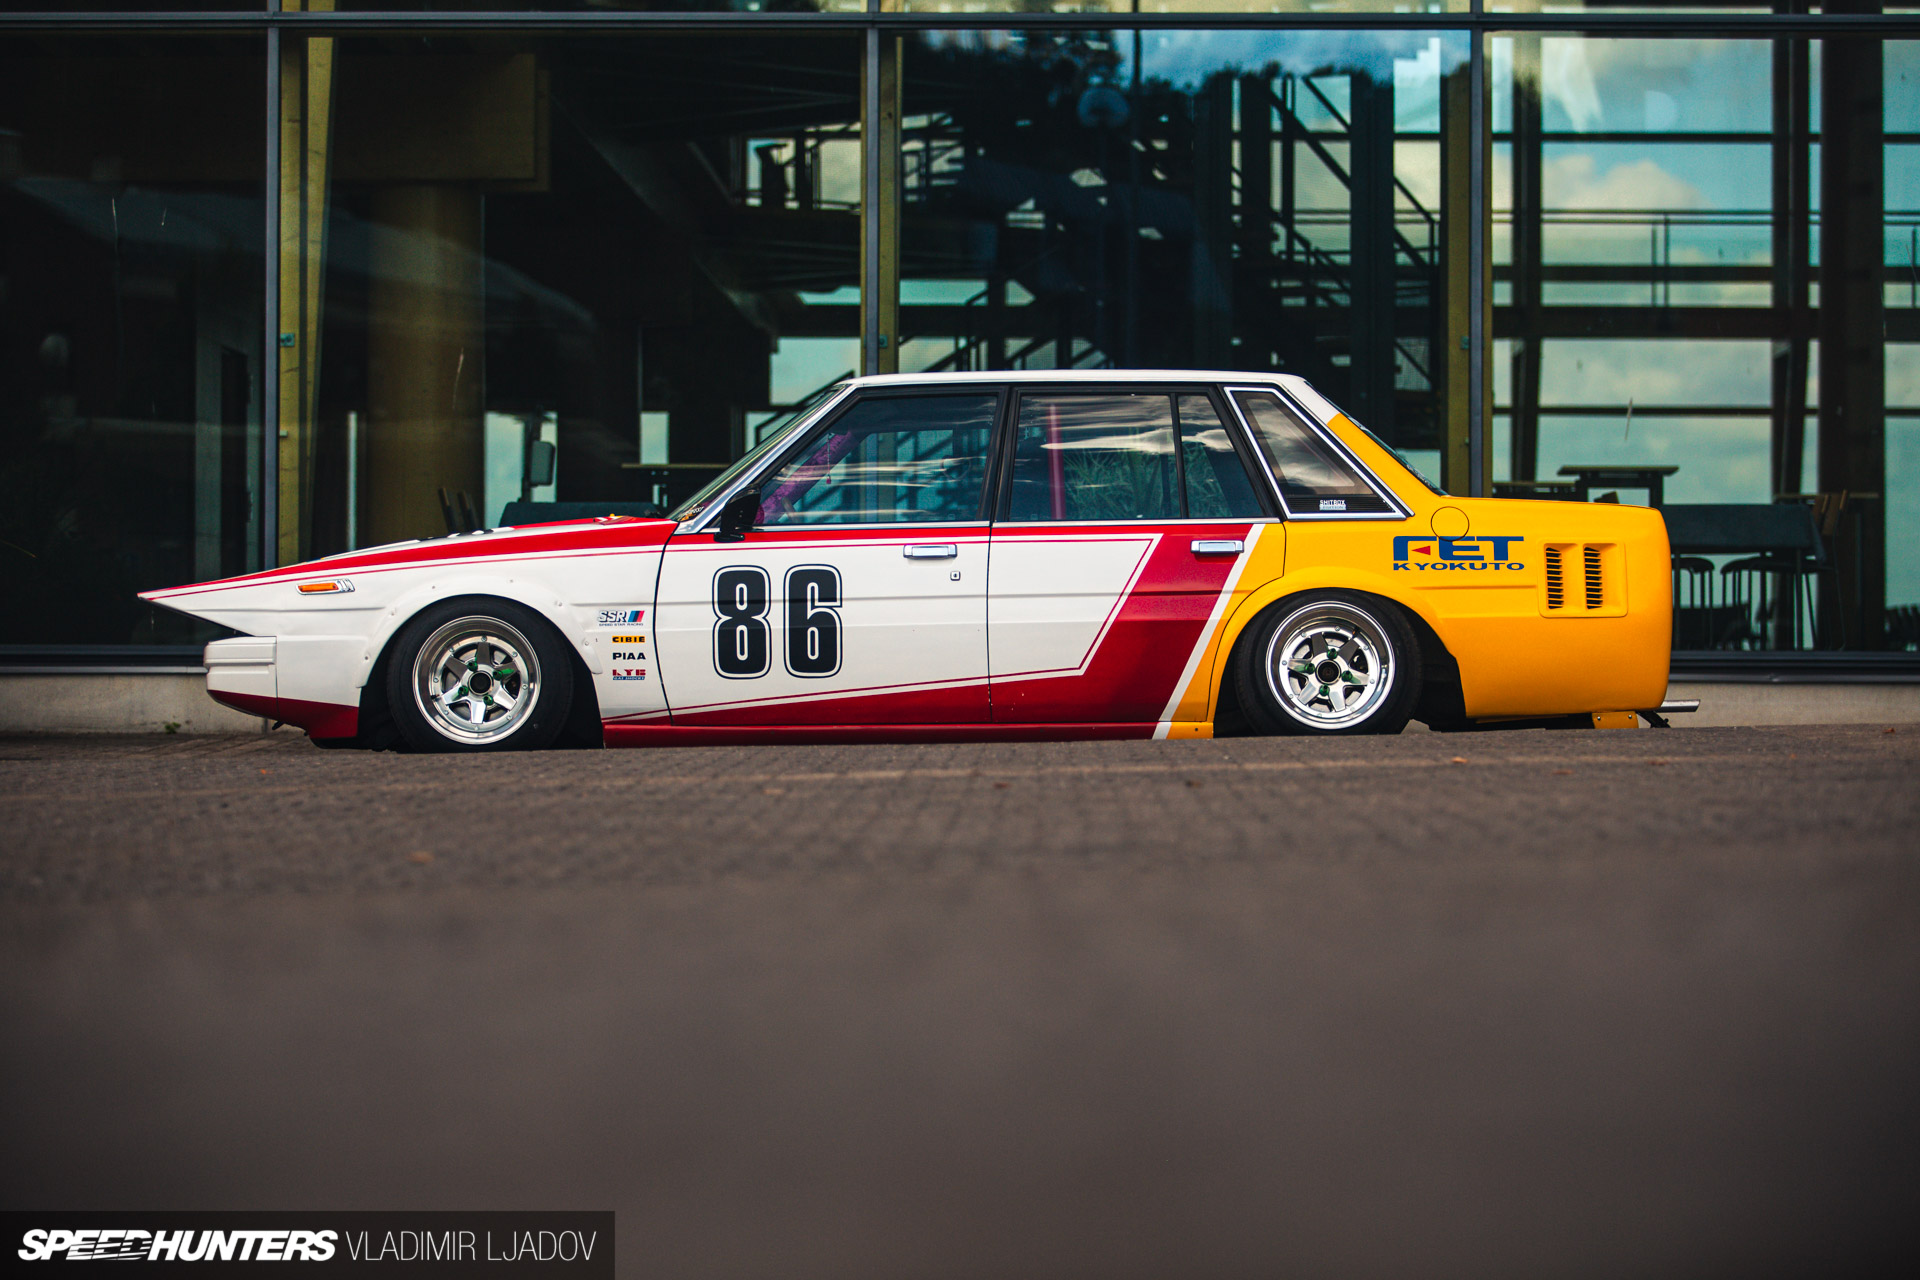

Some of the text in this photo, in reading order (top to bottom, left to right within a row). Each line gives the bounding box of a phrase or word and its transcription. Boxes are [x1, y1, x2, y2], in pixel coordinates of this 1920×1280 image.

[1393, 536, 1524, 561] FET
[1393, 563, 1525, 571] KYOKUTO
[598, 610, 627, 622] SSR
[712, 563, 843, 680] 86
[612, 652, 646, 660] PIAA
